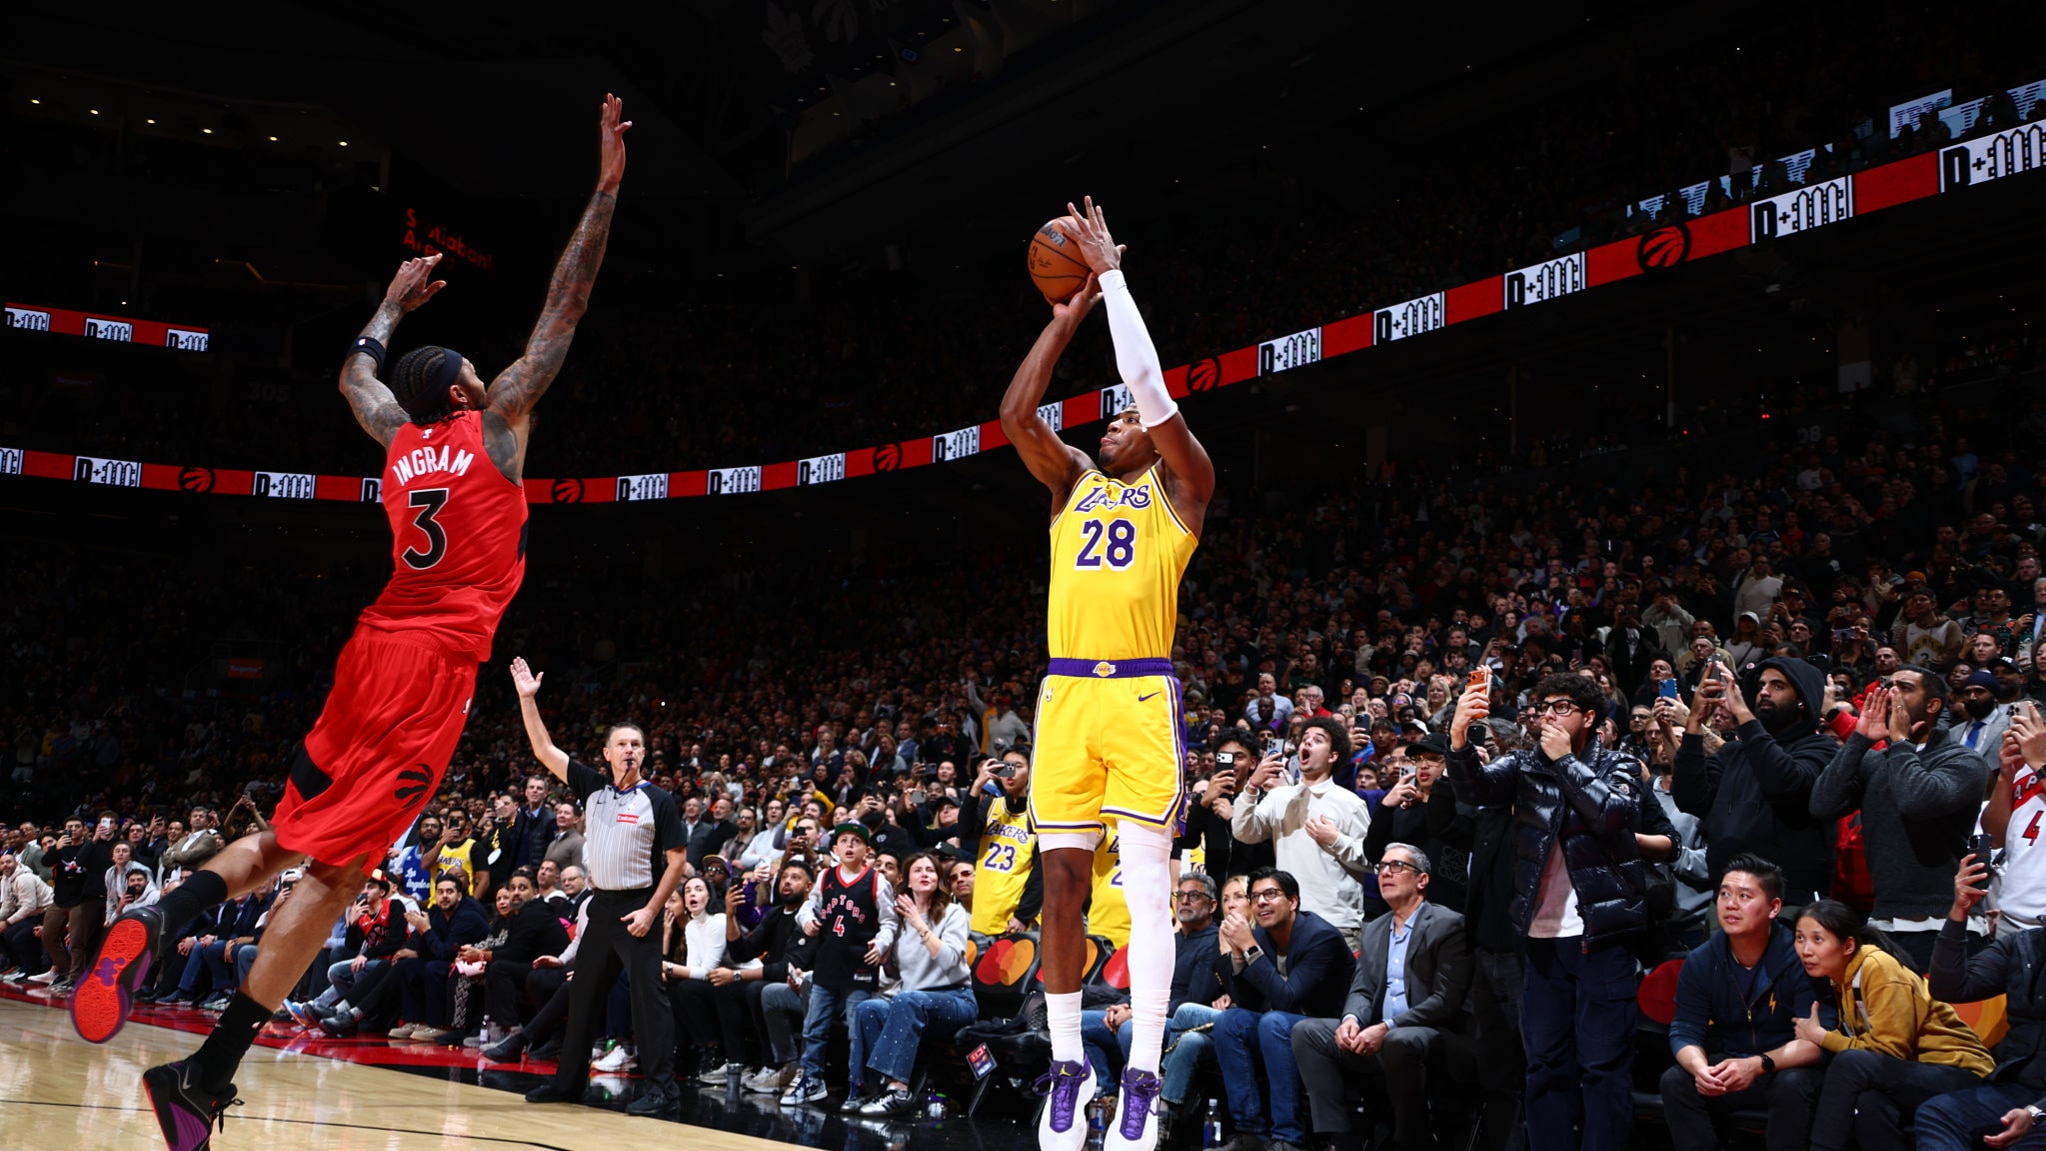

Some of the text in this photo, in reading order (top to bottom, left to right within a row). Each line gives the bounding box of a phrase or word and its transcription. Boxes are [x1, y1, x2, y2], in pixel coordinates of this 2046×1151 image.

[392, 445, 475, 487] INGRAM
[1074, 484, 1151, 513] LARS
[401, 487, 450, 571] 3
[1074, 519, 1136, 571] 28
[983, 819, 1028, 844] LAKERS
[2022, 810, 2044, 846] 4
[984, 842, 1016, 873] 23
[820, 894, 866, 925] RAPTORS
[832, 915, 846, 938] 4
